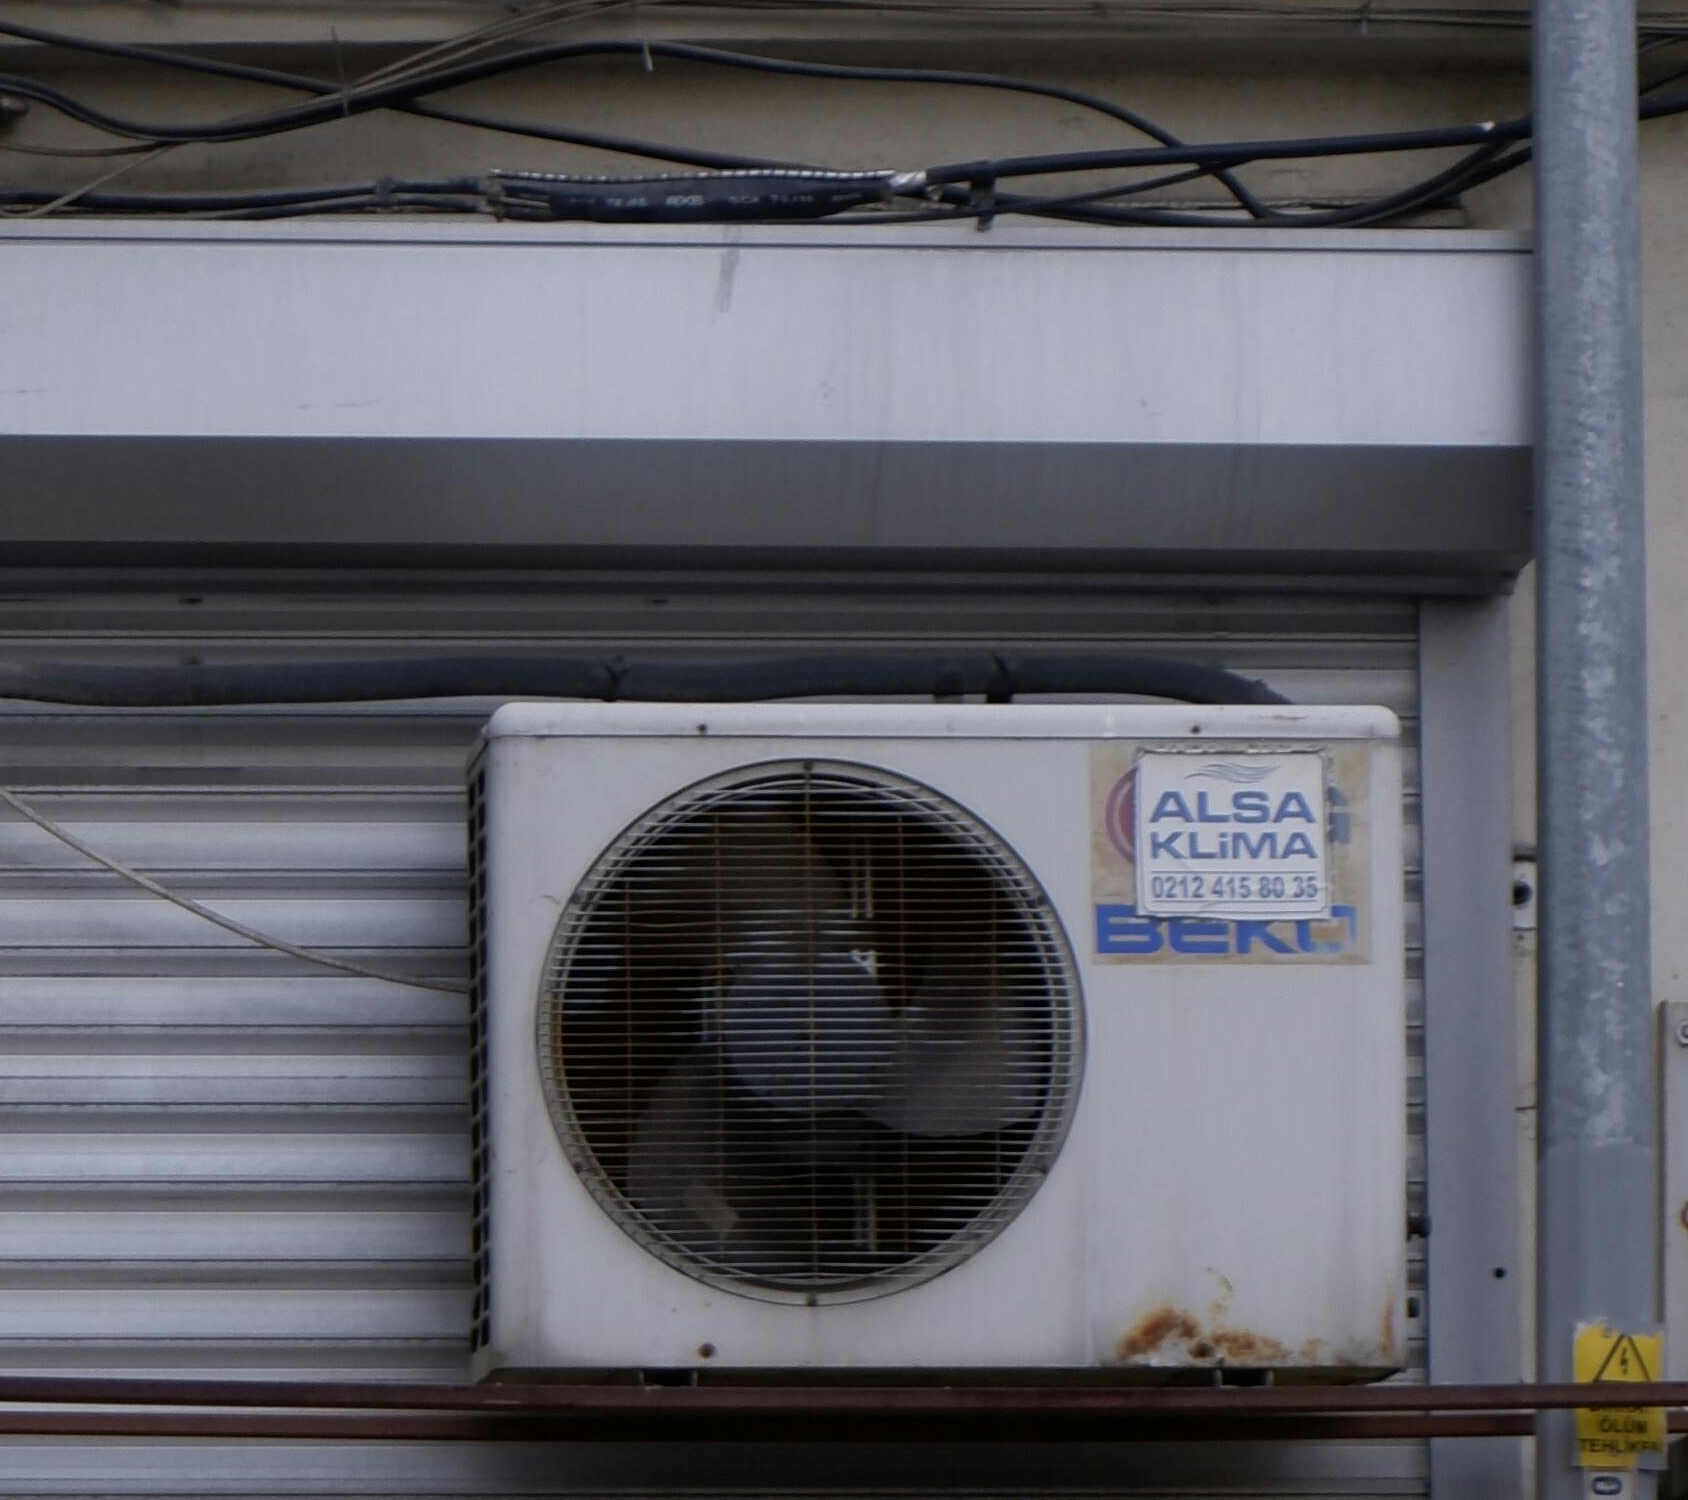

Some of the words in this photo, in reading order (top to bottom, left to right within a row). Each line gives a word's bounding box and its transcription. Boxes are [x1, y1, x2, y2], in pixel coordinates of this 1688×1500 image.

[1149, 791, 1316, 823] ALSA
[1152, 876, 1204, 899] 0212
[1212, 876, 1251, 899] 415
[1293, 876, 1318, 899] 35
